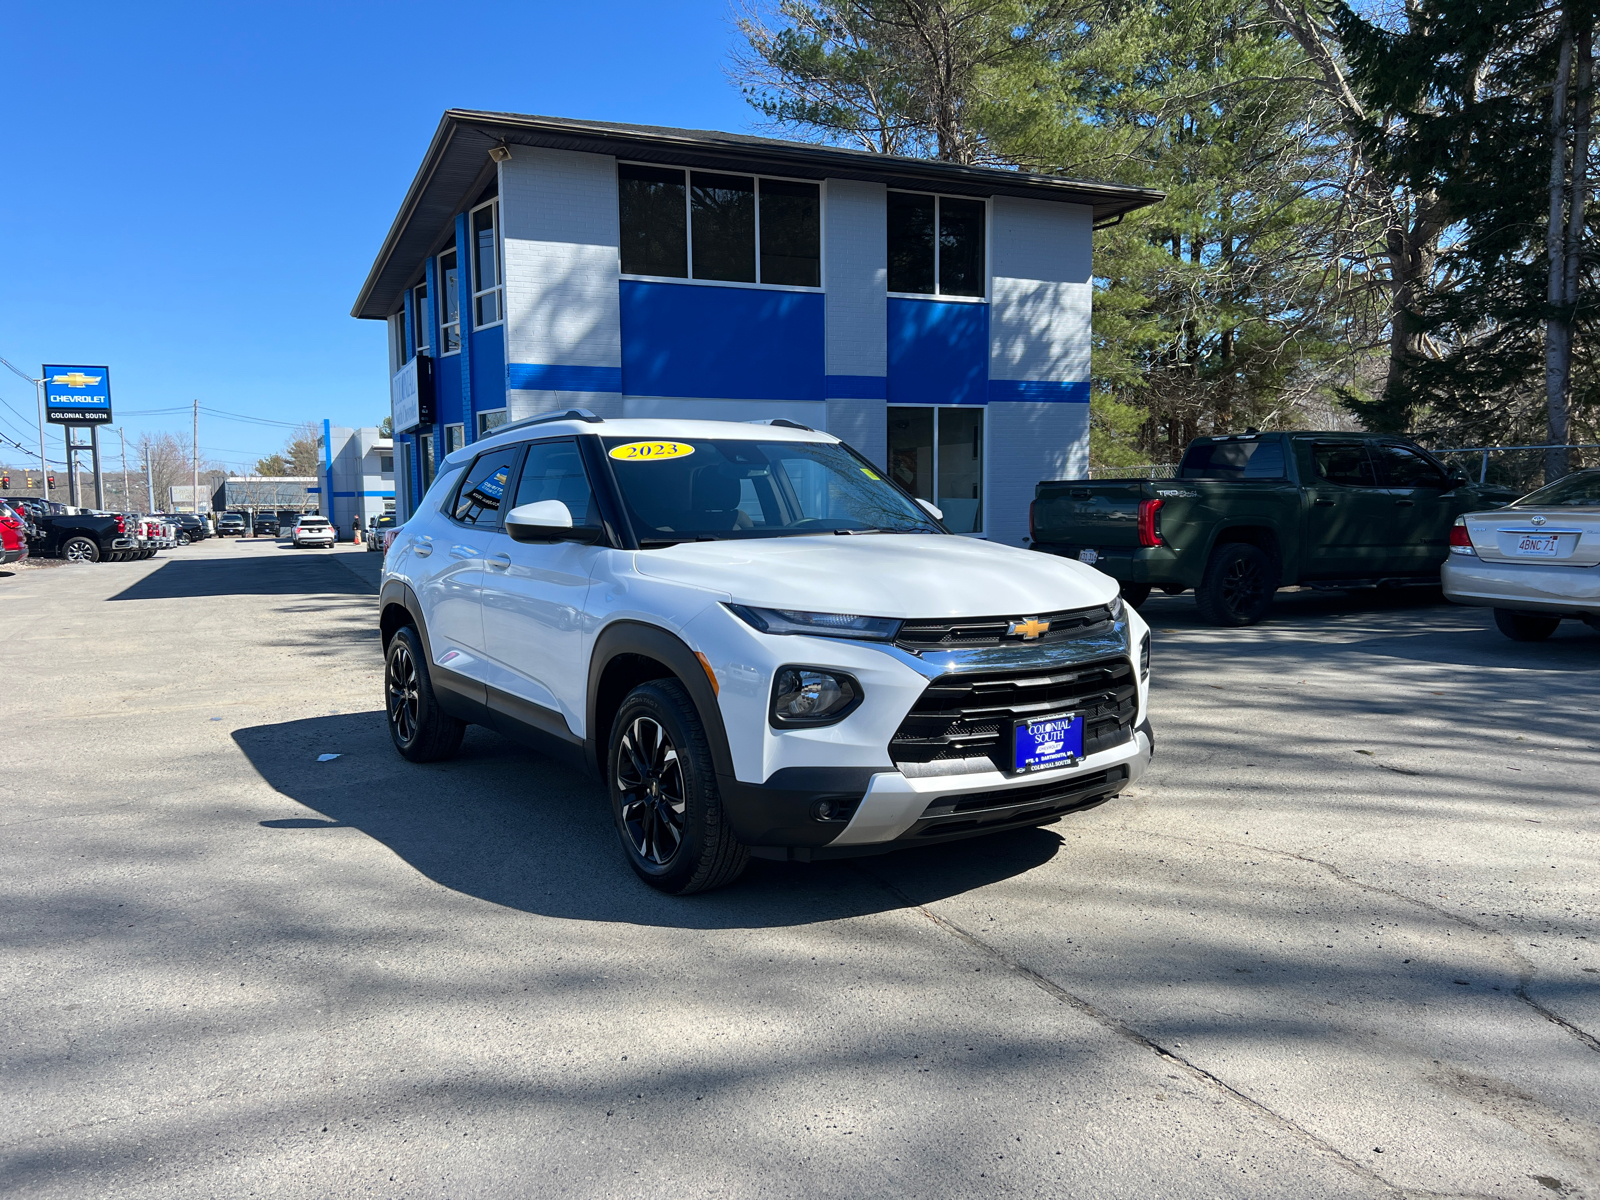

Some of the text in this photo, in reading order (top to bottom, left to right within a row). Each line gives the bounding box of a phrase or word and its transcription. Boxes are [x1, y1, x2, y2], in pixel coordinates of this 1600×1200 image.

[50, 395, 106, 403] CHEVROLET
[626, 443, 678, 458] 2023
[1518, 539, 1556, 552] 4BNC 71
[1028, 720, 1071, 735] COLONIAL
[1035, 730, 1064, 743] SOUTH
[1055, 759, 1071, 767] SOUTH
